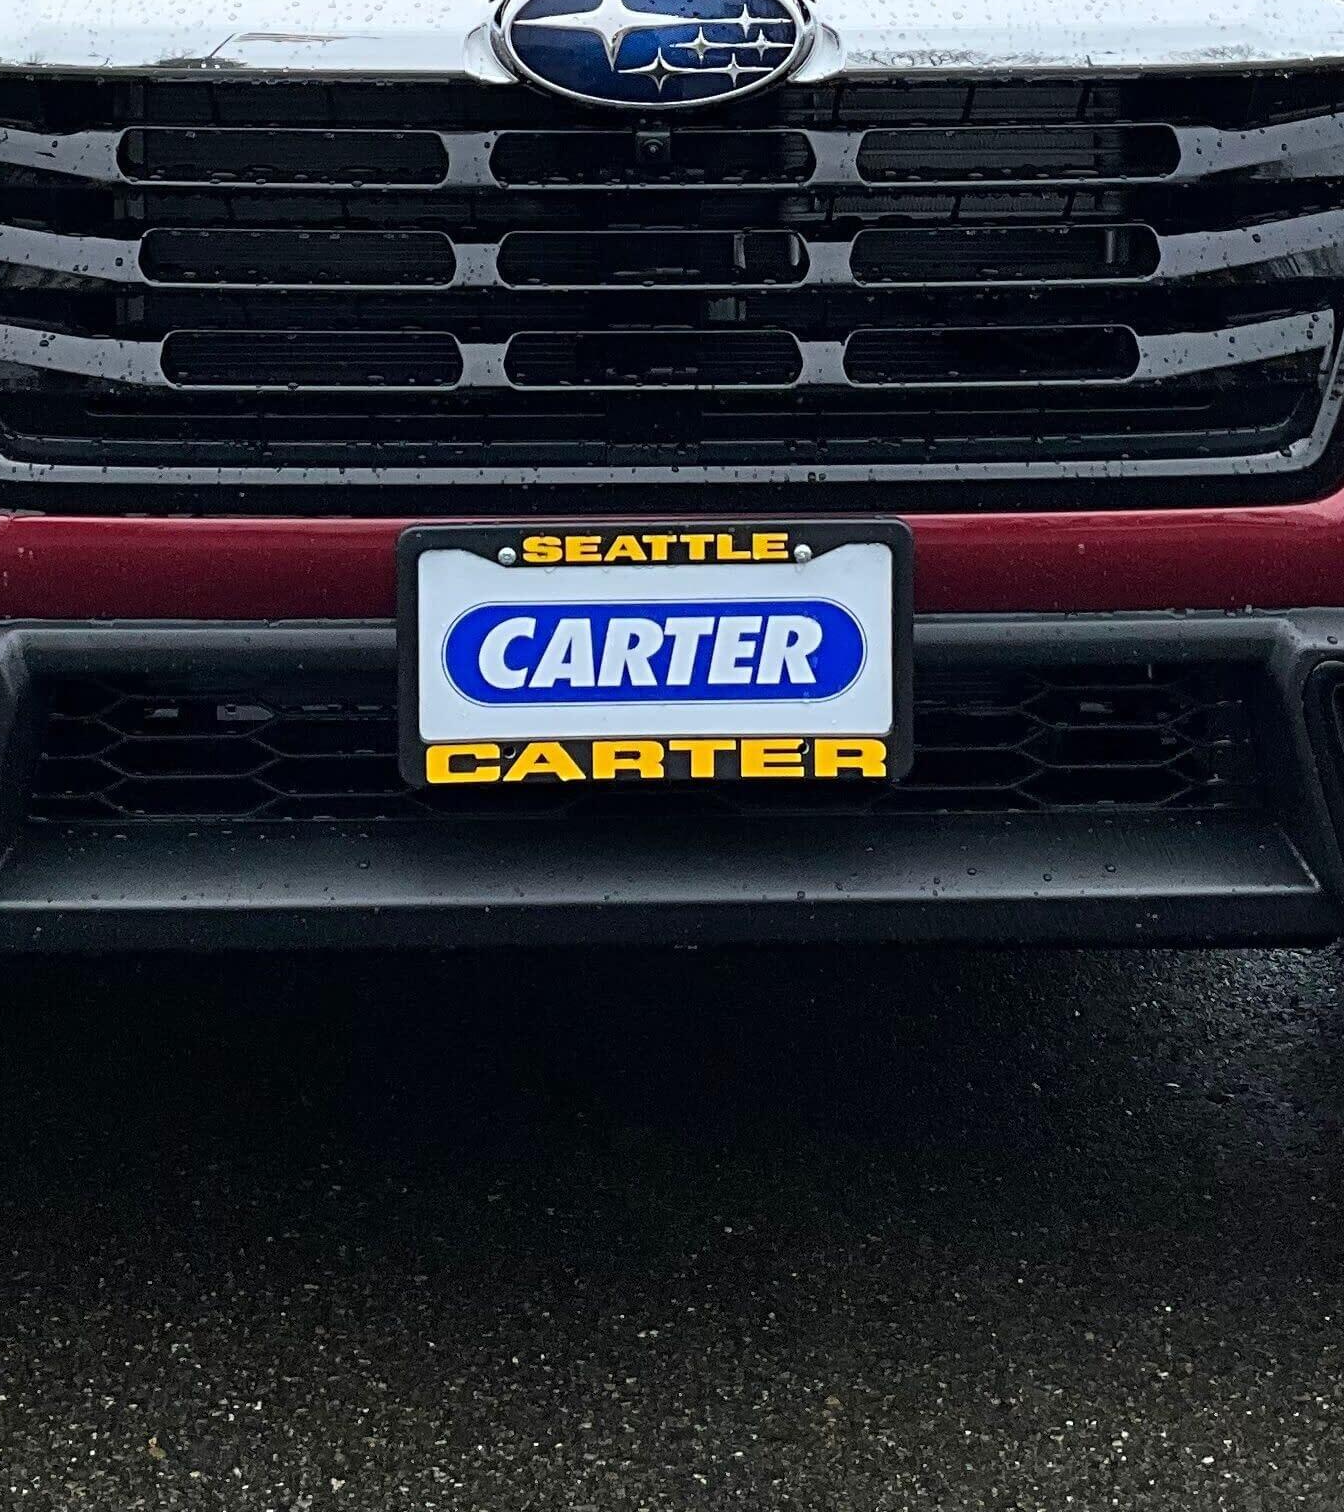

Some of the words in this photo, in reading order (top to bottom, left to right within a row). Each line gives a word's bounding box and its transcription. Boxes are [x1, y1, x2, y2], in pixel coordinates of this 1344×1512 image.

[522, 531, 789, 563] SEATTLE
[477, 614, 823, 689] CARTER
[426, 738, 887, 784] CARTER
